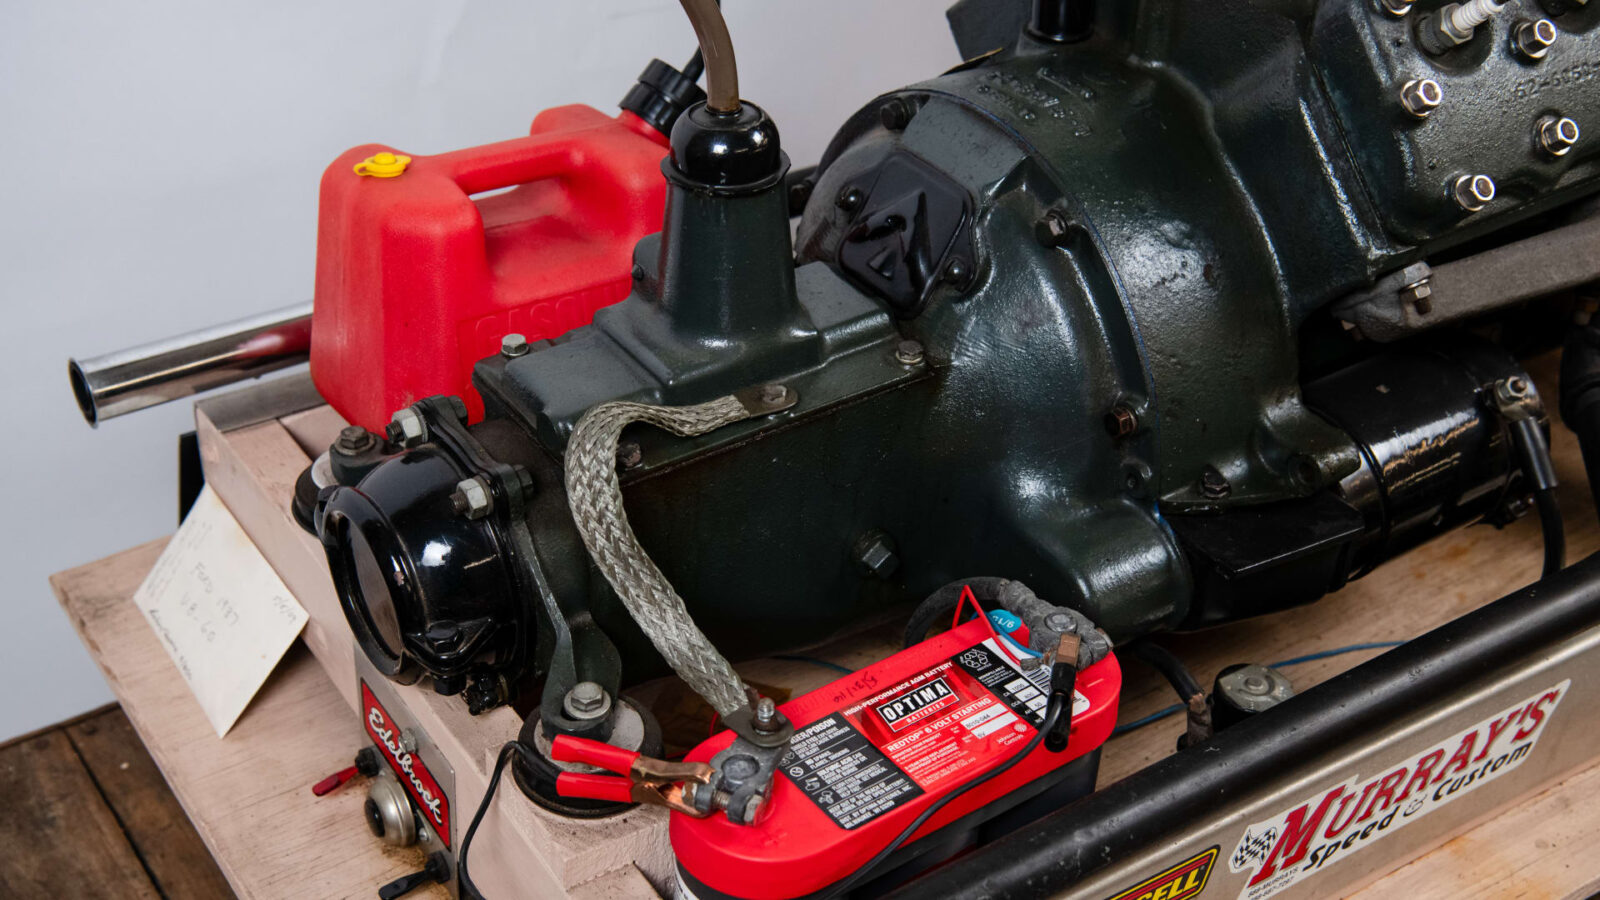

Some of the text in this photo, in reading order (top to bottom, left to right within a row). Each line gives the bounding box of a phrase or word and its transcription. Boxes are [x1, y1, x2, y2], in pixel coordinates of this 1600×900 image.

[843, 661, 953, 716] HIGH-PERFORMANCE AGM BATTERY
[882, 682, 949, 721] OPTIMA
[790, 717, 836, 744] GER/POISON
[906, 702, 945, 723] BATTERIES
[931, 717, 952, 731] VOLT
[952, 698, 992, 719] STARTING
[368, 707, 442, 825] Edelbrock
[1247, 689, 1559, 888] MURRAY'S
[1302, 805, 1399, 872] Speed
[1432, 741, 1533, 802] Custom
